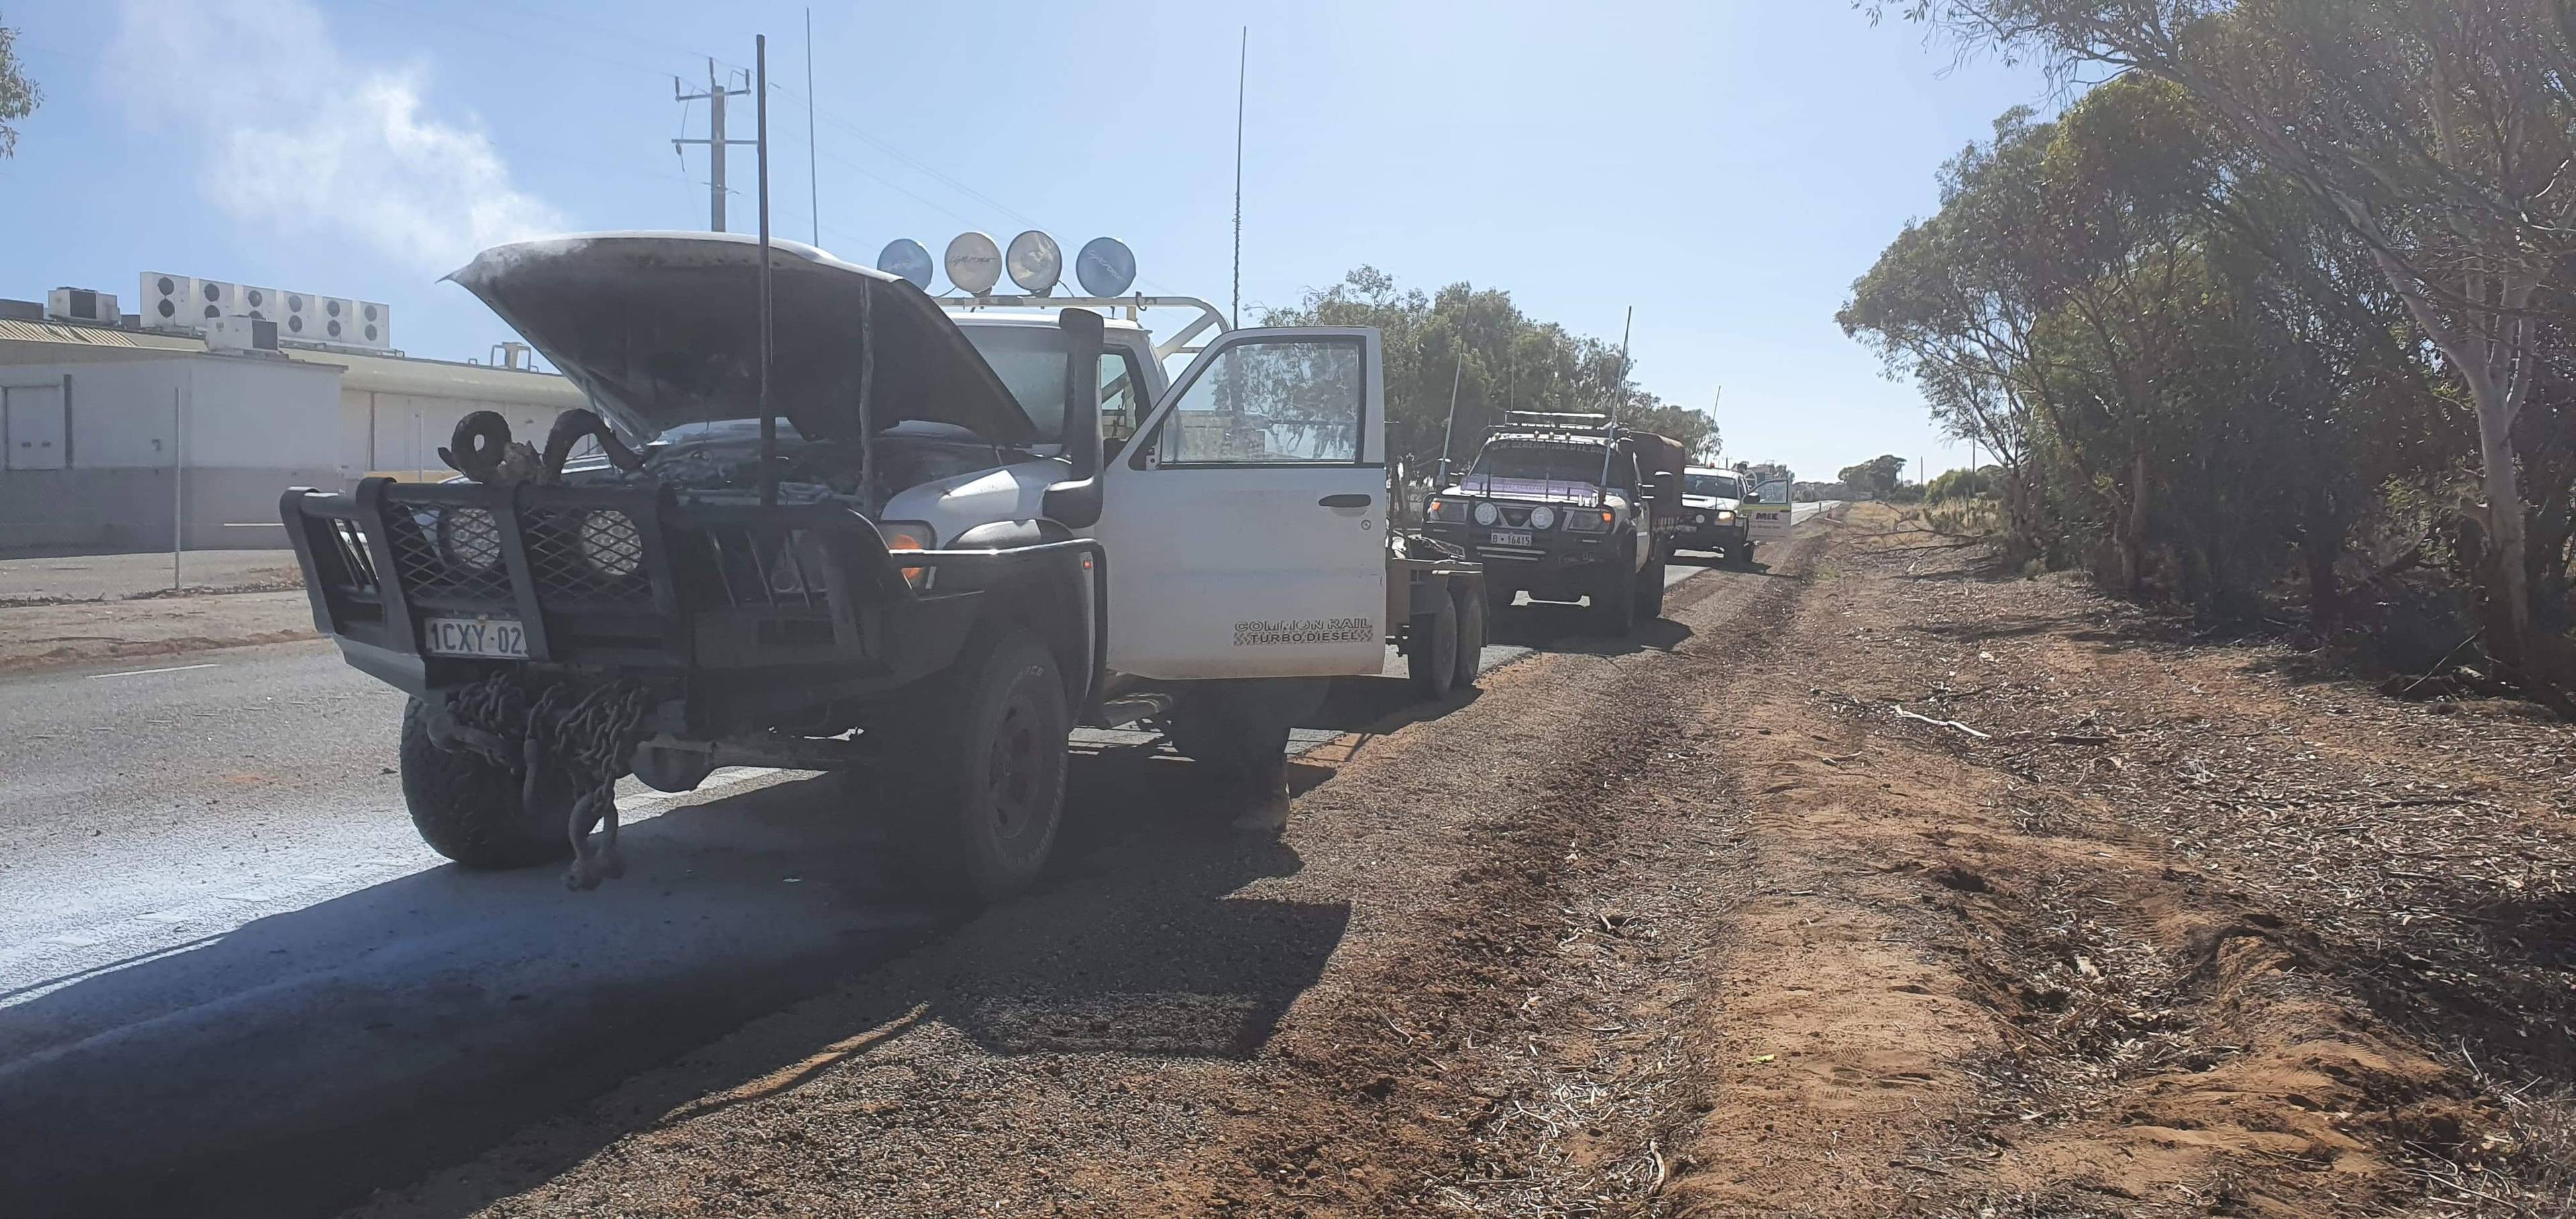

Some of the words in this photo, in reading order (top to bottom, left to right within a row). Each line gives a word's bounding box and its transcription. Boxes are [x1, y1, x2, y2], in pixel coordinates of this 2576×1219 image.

[1234, 619, 1324, 632] COMMON
[1328, 618, 1373, 629] RAIL
[1251, 633, 1302, 643] TURBO
[1307, 631, 1359, 641] DIESEL
